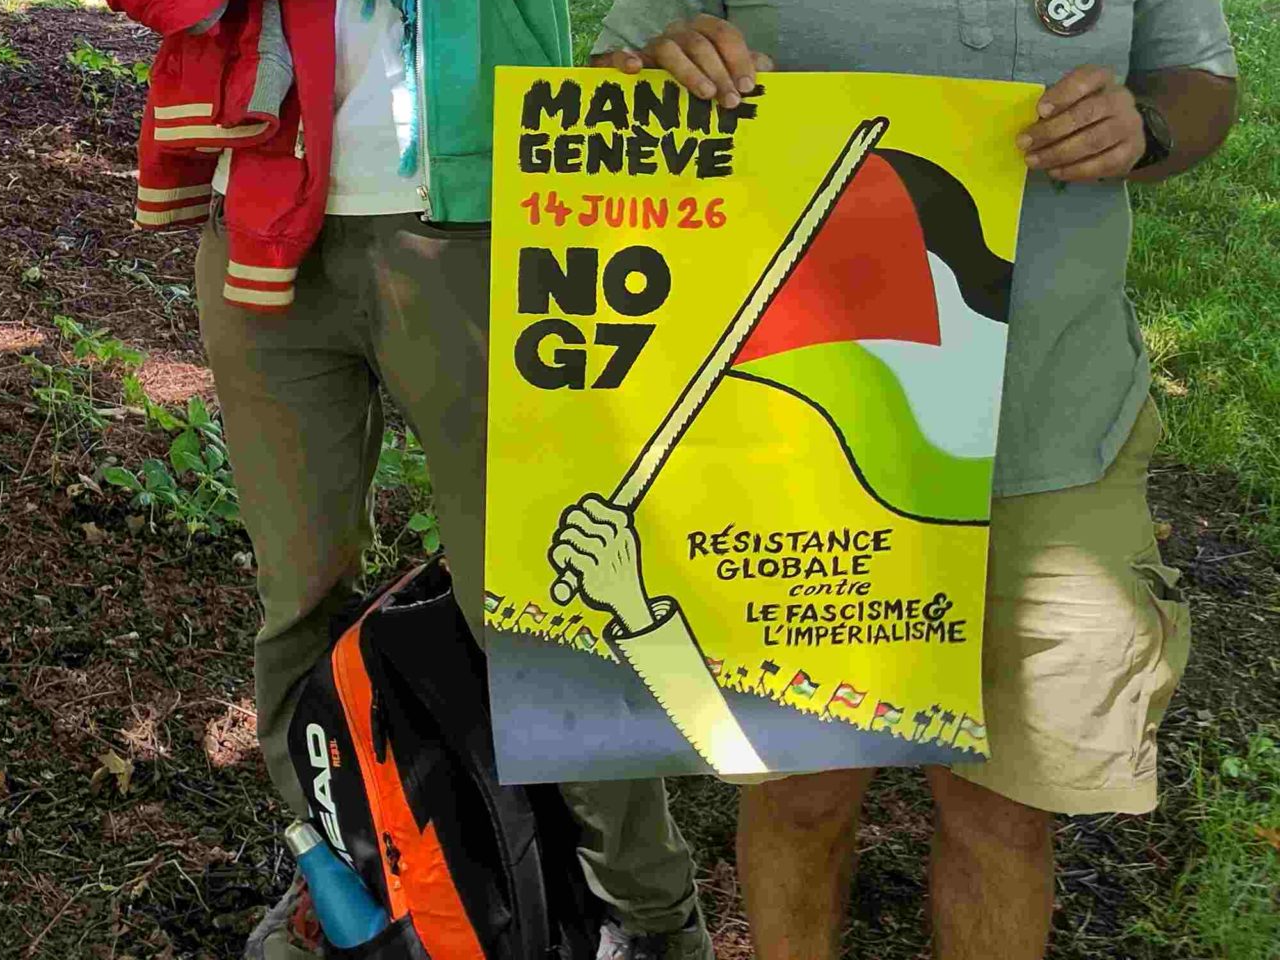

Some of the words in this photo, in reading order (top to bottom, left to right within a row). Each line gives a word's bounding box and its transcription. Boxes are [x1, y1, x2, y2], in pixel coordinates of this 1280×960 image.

[521, 78, 766, 134] MANIF
[519, 124, 734, 179] GENÈVE
[521, 191, 572, 226] 14
[578, 195, 669, 229] JUIN
[677, 197, 727, 229] 26
[518, 245, 671, 316] NO
[514, 318, 657, 390] G7
[687, 522, 893, 560] RÉSISTANCE
[716, 554, 872, 580] GLOBALE
[789, 579, 871, 597] contre
[746, 601, 780, 622] LE
[786, 598, 921, 623] FASCISME
[921, 592, 953, 621] &
[764, 620, 967, 647] L'IMPÉRIALISME
